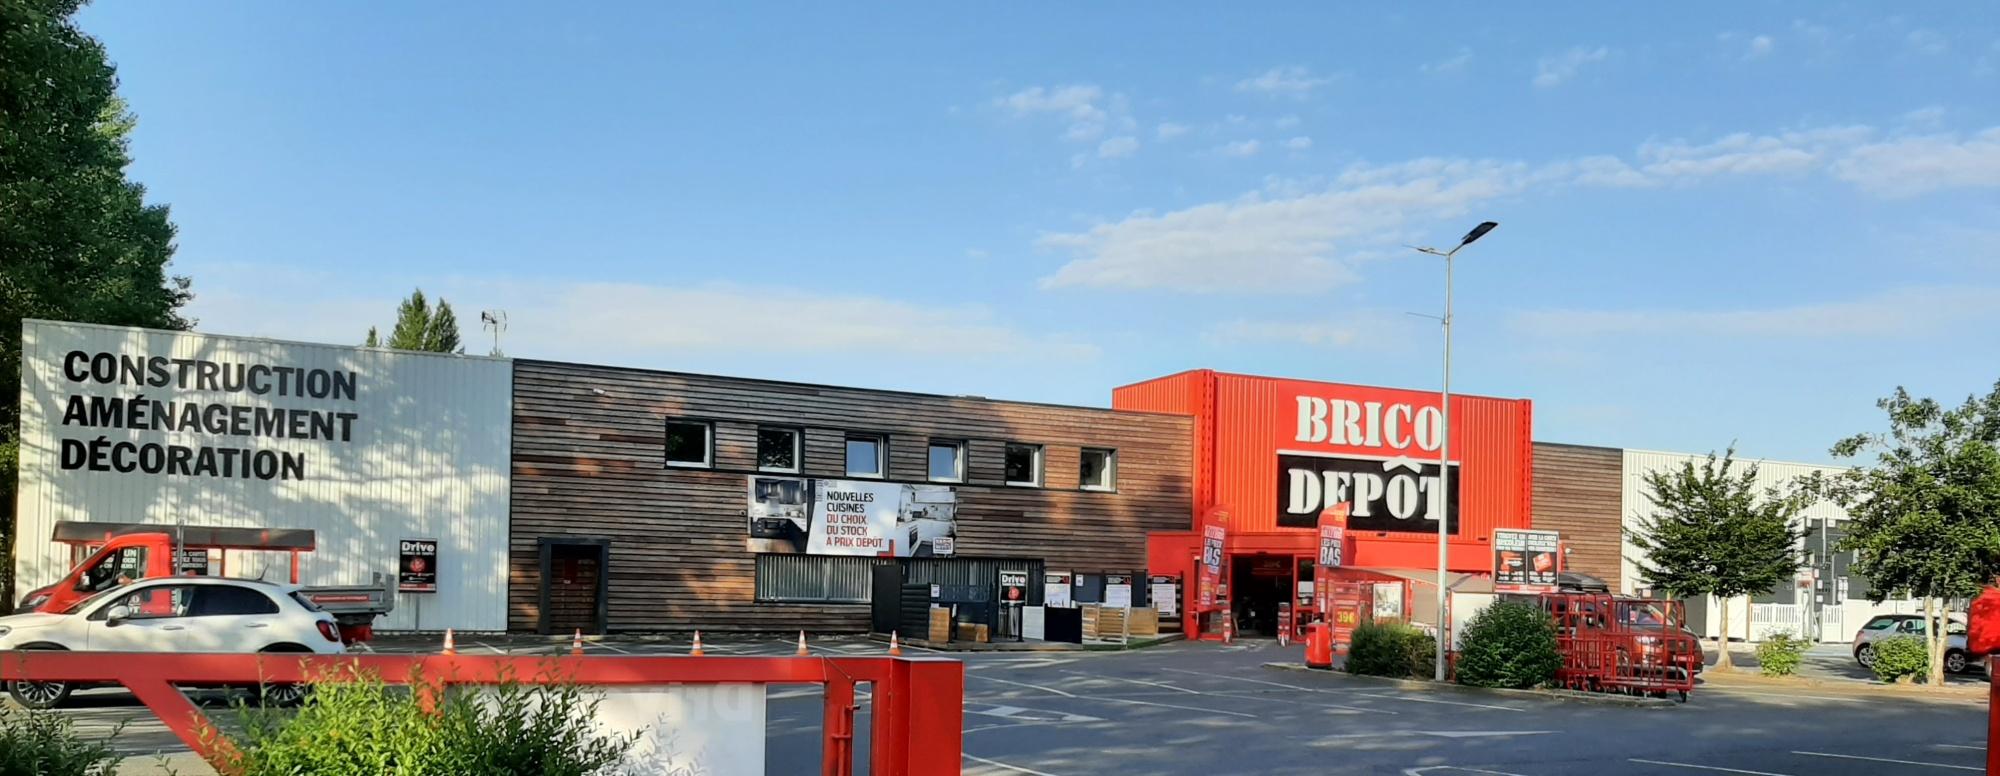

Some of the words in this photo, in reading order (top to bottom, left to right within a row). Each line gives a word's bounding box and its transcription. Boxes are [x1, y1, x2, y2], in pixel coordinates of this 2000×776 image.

[63, 350, 357, 400] CONSTRUCTION
[62, 394, 358, 442] AMÉNAGEMENT
[1295, 396, 1443, 451] BRICO
[60, 435, 305, 481] DÉCORATION
[1287, 455, 1441, 520] DEPÔT
[826, 491, 874, 503] NOUVELLES
[826, 502, 865, 513] CUISINES
[826, 514, 839, 524] DU
[840, 514, 867, 525] CHOIX
[826, 525, 839, 535] DU
[840, 525, 868, 536] STOCK
[401, 541, 435, 552] Drive
[834, 536, 854, 547] PRIX
[1320, 546, 1341, 567] BAS
[1001, 574, 1026, 583] Drive
